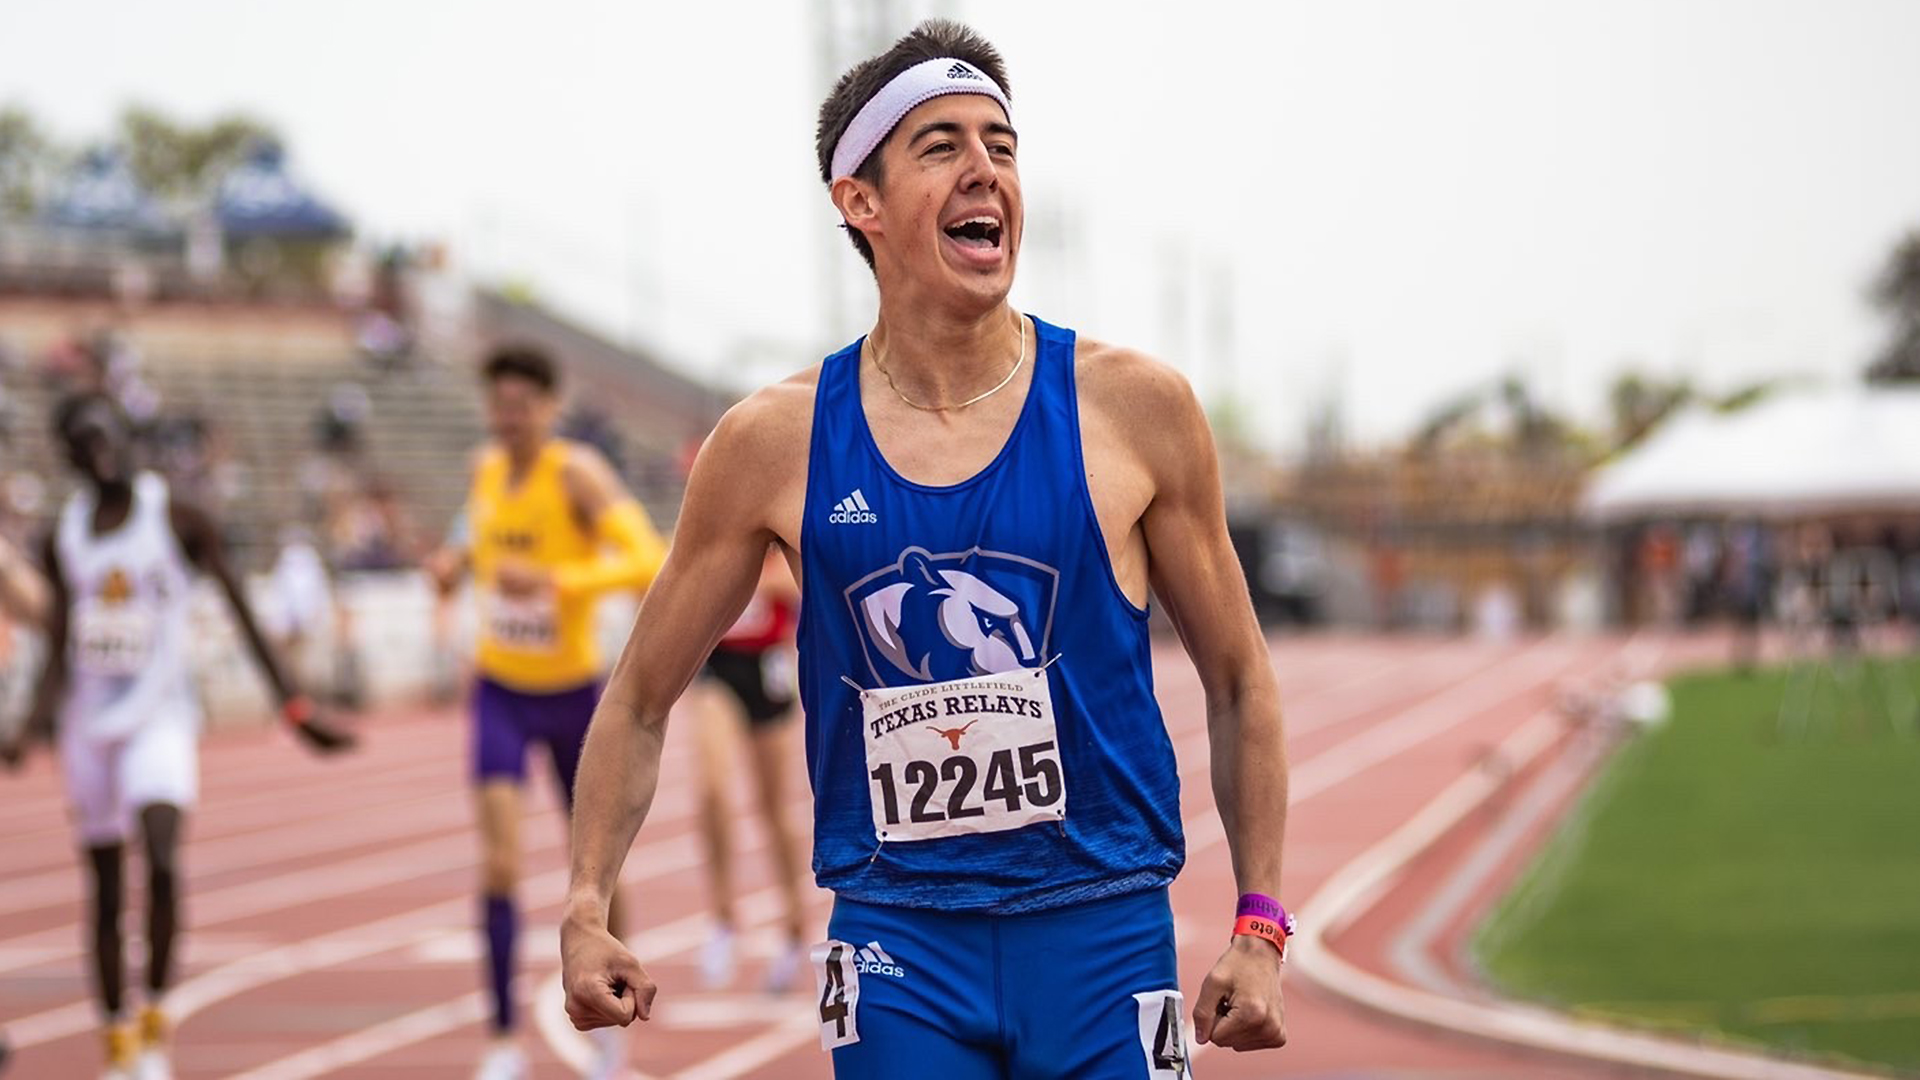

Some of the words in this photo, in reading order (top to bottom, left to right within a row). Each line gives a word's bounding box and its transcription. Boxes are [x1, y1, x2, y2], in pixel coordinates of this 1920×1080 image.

[829, 511, 878, 524] adidas
[870, 700, 938, 739] TEXAS
[943, 694, 1043, 719] RELAYS
[878, 697, 898, 711] THE
[900, 687, 938, 702] CLYDE
[941, 682, 1024, 693] LITTLEFIELD
[871, 740, 1063, 826] 12245
[820, 945, 849, 1039] 4
[856, 961, 905, 978] didas
[1152, 996, 1185, 1080] 4
